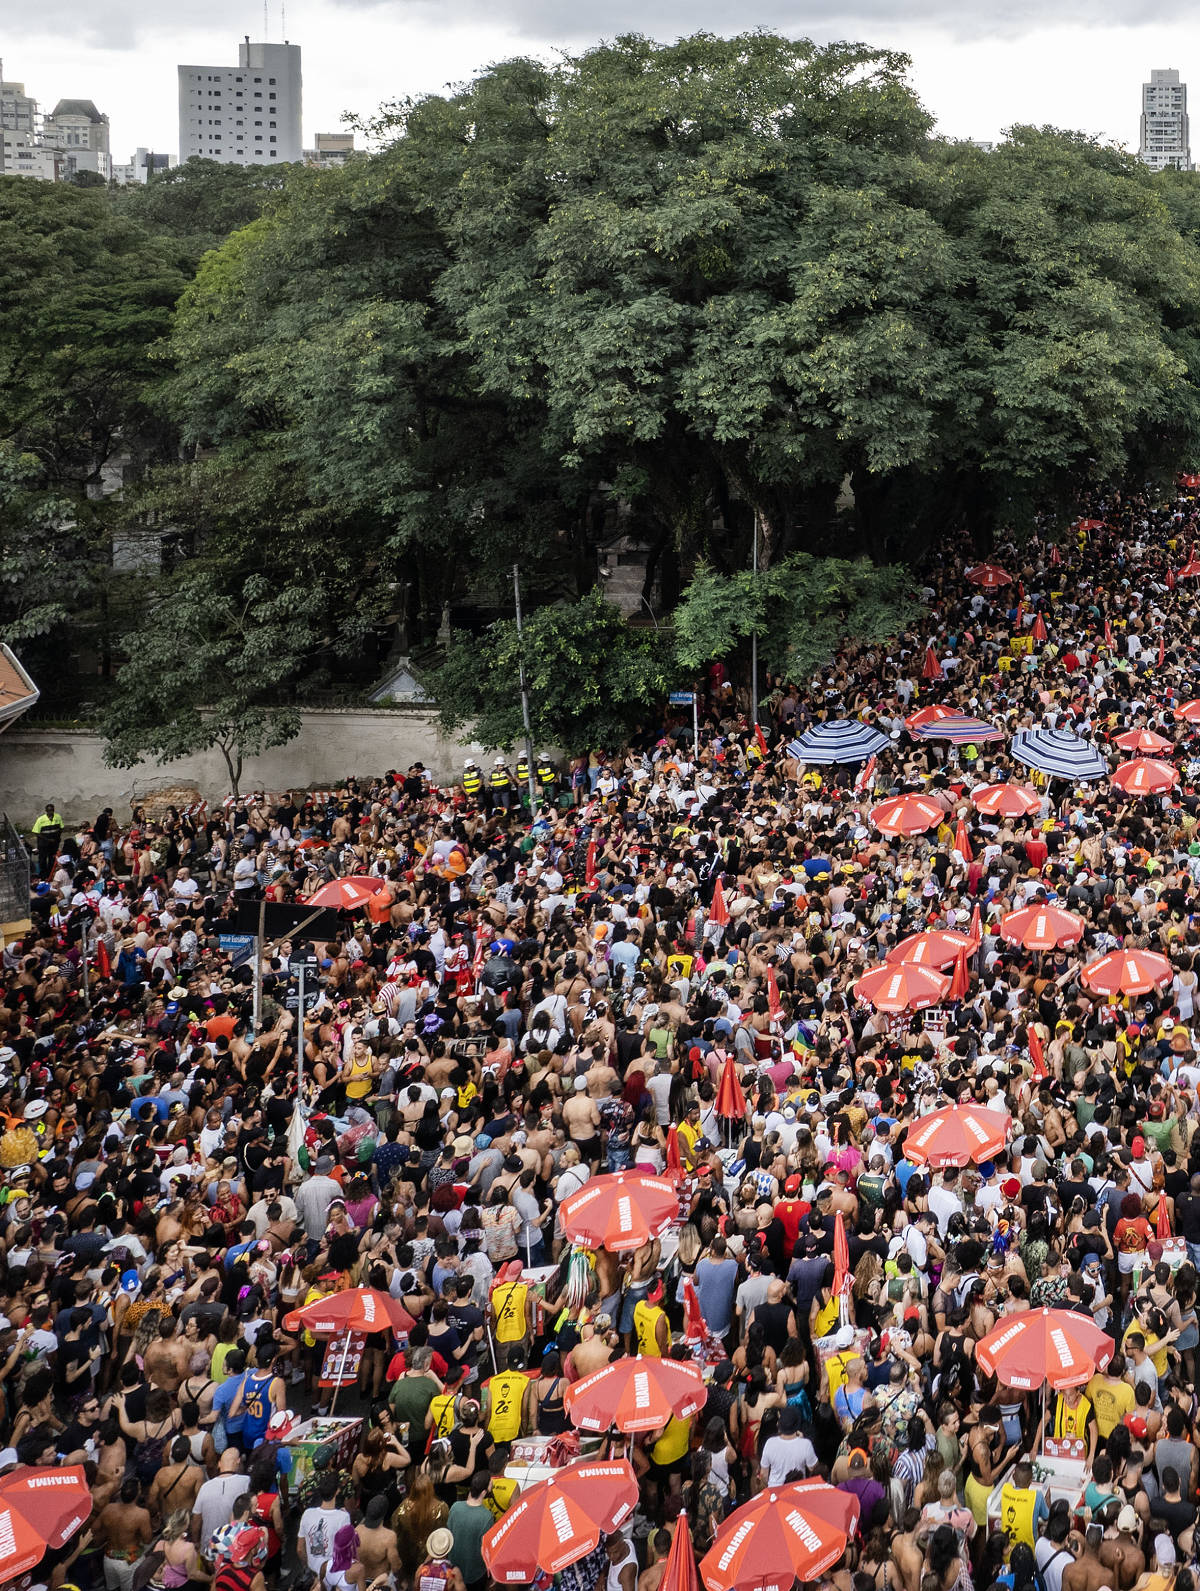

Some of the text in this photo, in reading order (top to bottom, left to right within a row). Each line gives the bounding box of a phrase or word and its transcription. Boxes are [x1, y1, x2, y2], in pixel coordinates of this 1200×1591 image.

[568, 1188, 601, 1215] BRAHMA
[618, 1196, 632, 1232] BRAHMA
[503, 1307, 516, 1320] Zé
[989, 1322, 1026, 1354] BRAHMA
[1050, 1328, 1074, 1368] BRAHMA
[575, 1366, 615, 1395] BRAHMA
[634, 1372, 650, 1408] BRAHMA
[494, 1400, 512, 1415] Zé
[28, 1476, 78, 1488] BRAHMA
[492, 1502, 528, 1547] BRAHMA
[549, 1497, 574, 1543] BRAHMA
[785, 1510, 822, 1552] BRAHMA
[718, 1521, 754, 1571] BRAHMA
